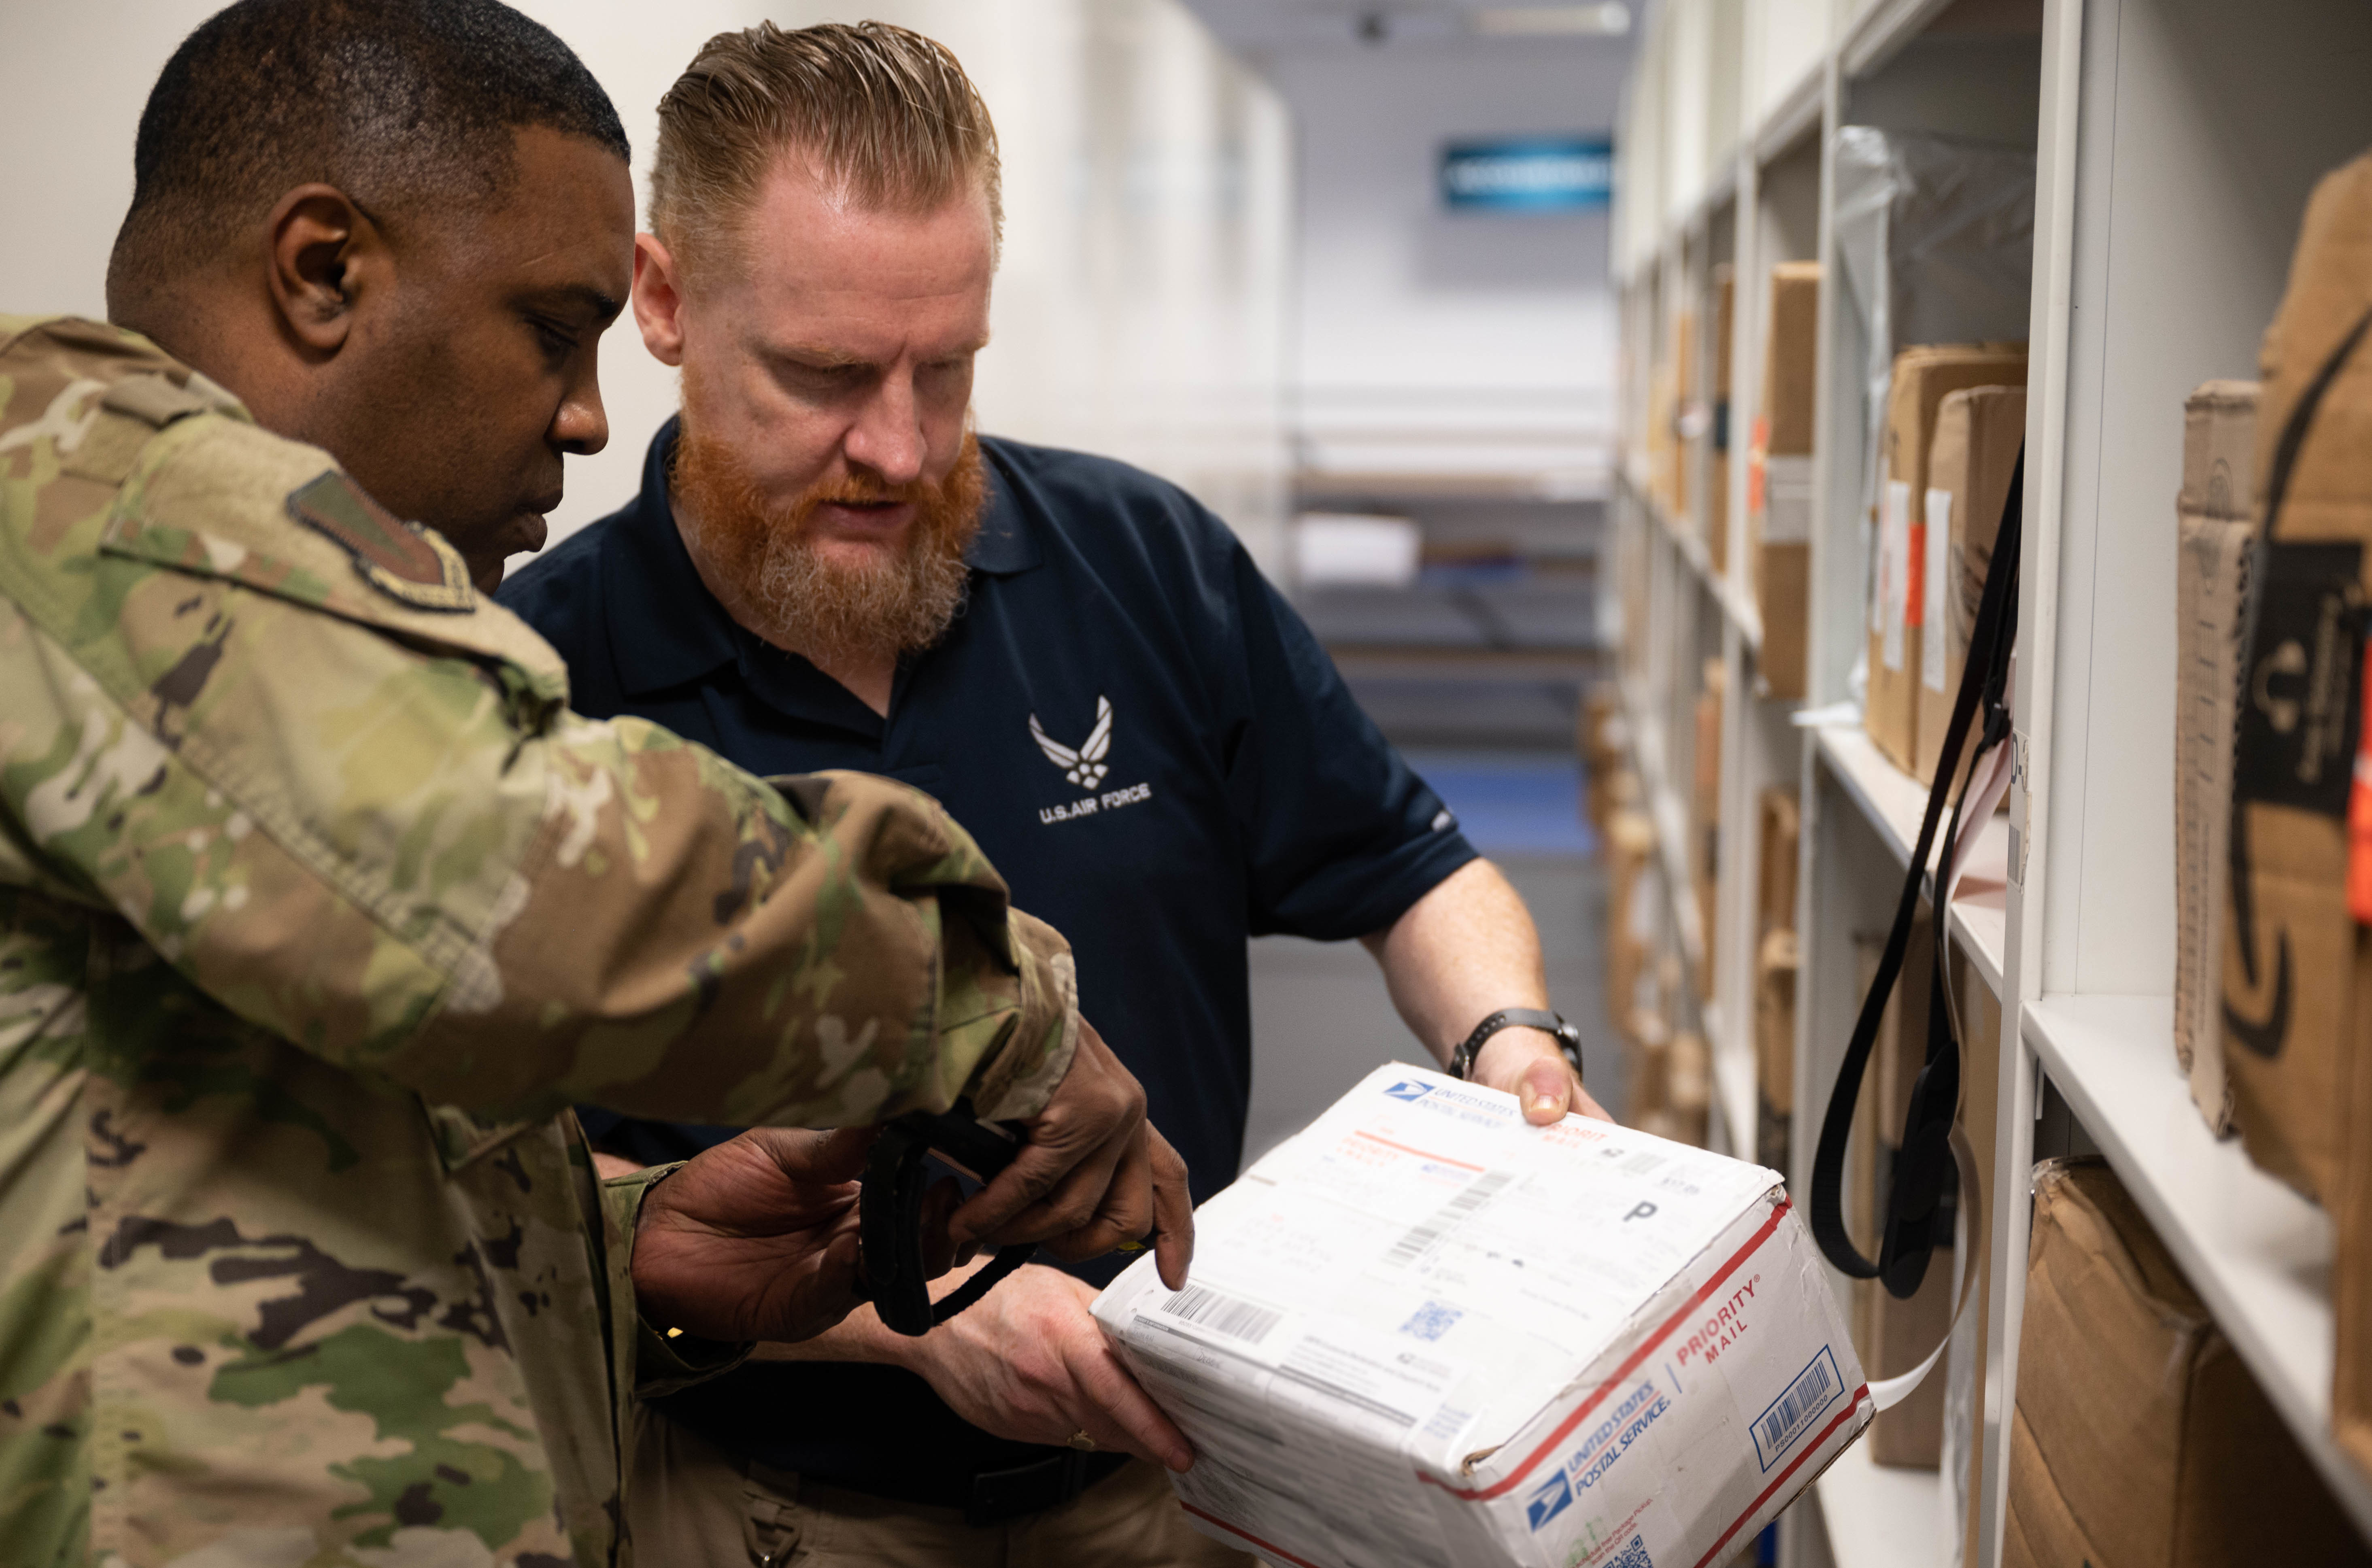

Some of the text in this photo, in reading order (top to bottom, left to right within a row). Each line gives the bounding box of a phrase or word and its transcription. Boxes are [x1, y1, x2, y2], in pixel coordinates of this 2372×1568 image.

[1101, 782, 1152, 809] FORCE
[1434, 1088, 1519, 1117] UNITED STATES
[1622, 1200, 1658, 1222] P
[1705, 1319, 1748, 1364] MAIL
[1567, 1420, 1613, 1473] UNITED
[1611, 1379, 1654, 1428] STATES
[1775, 1394, 1828, 1452] PS00011000000
[1575, 1446, 1621, 1496] POSTAL
[1601, 1536, 1612, 1547] free
[1612, 1515, 1634, 1537] Package
[1592, 1552, 1605, 1566] scan
[1605, 1543, 1615, 1554] the
[1614, 1534, 1624, 1545] QR
